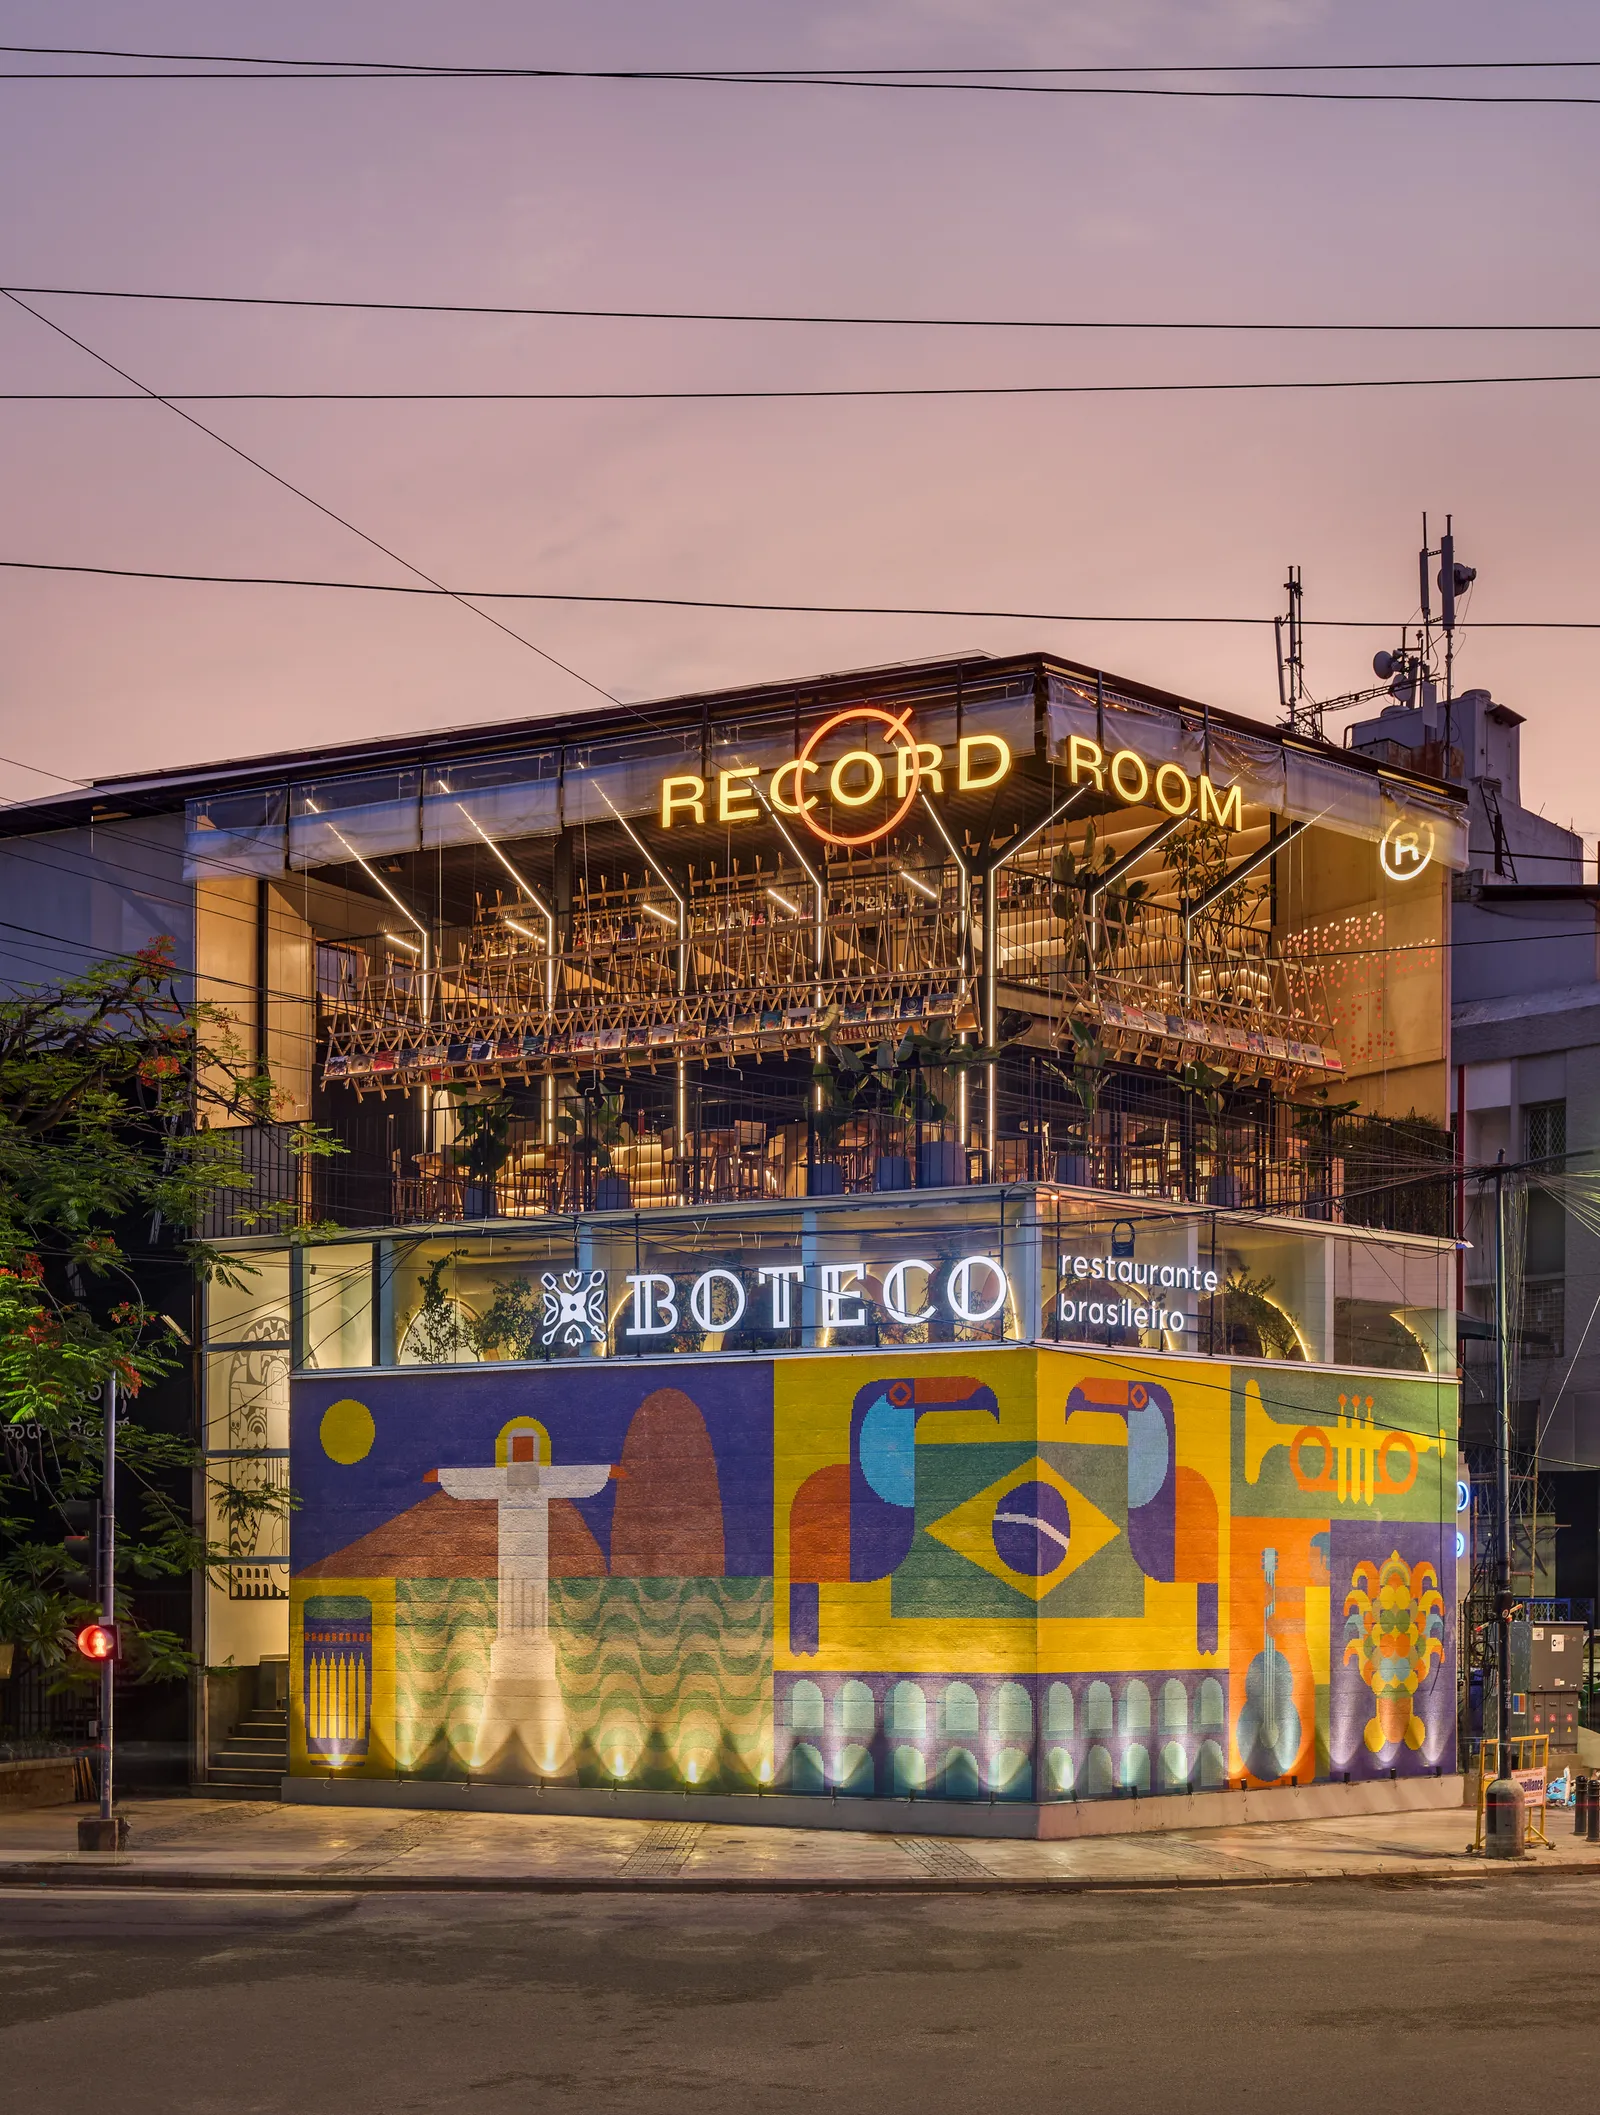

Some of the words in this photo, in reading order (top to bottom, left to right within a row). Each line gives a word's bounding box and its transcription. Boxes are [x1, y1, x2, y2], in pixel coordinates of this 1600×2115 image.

[661, 735, 1011, 829] RECORD
[1068, 734, 1242, 832] ROOM
[625, 1255, 1009, 1337] BOTECO
[1060, 1250, 1219, 1293] restaurante
[1060, 1294, 1186, 1333] brasileiro
